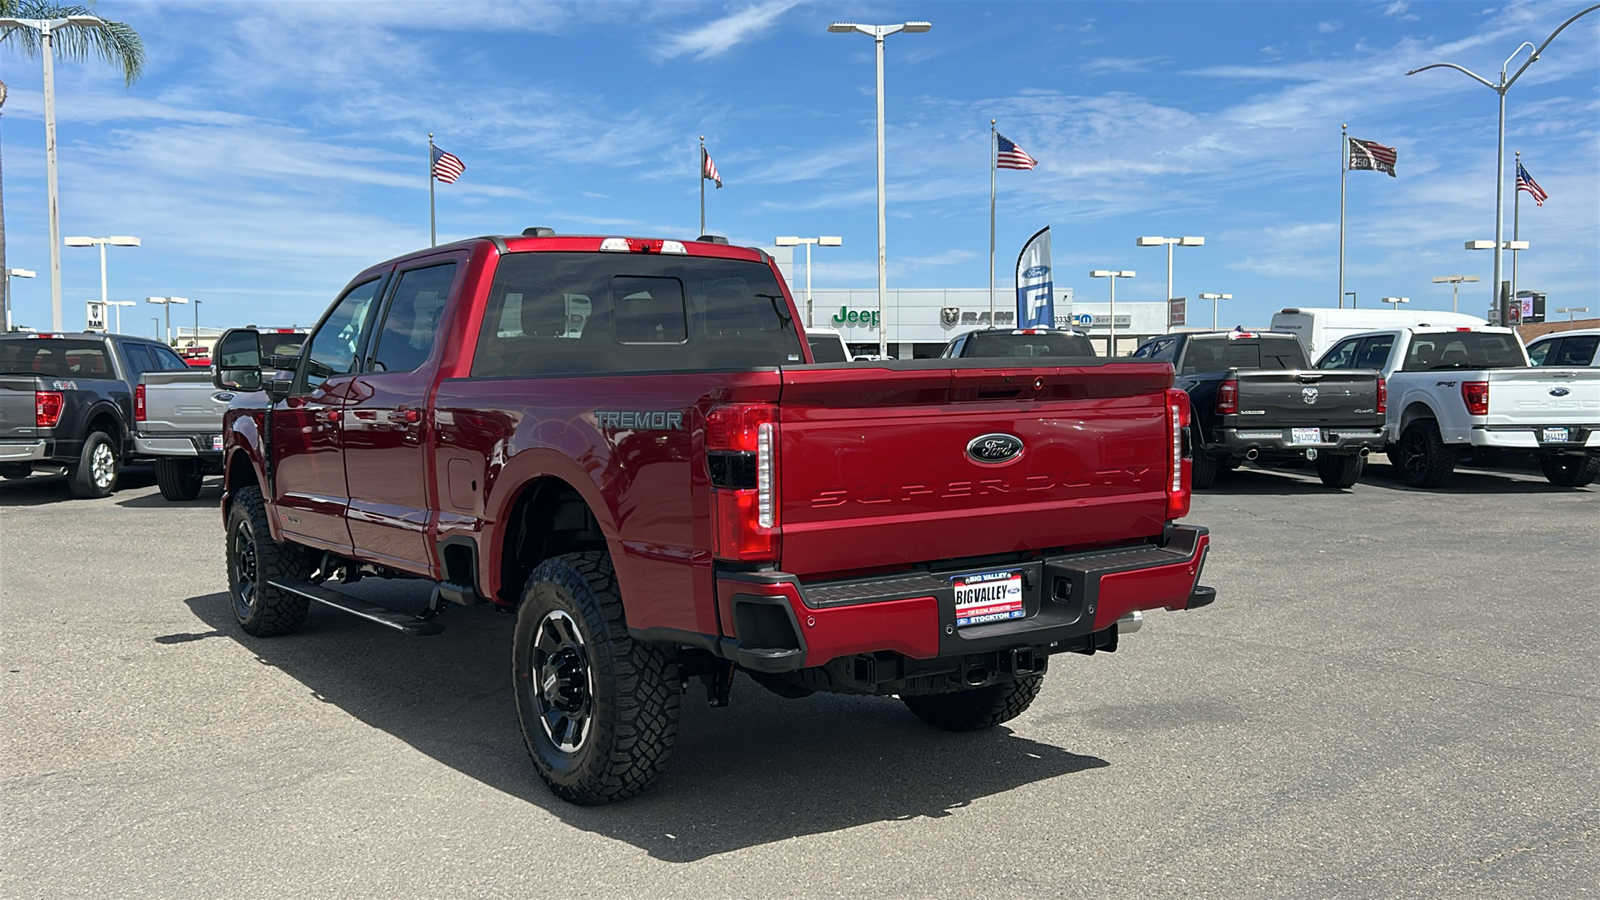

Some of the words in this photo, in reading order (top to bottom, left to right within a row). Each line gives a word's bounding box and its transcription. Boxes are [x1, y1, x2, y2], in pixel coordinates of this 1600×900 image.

[1351, 157, 1368, 167] 250
[1027, 267, 1046, 277] Ford
[833, 305, 880, 326] Jeep
[961, 311, 1014, 325] RAM
[594, 411, 683, 430] TREMOR
[981, 440, 1012, 456] Ford
[811, 478, 1011, 508] SUPER
[1026, 467, 1150, 492] DUTY
[983, 572, 1008, 580] VALLEY
[970, 612, 1010, 623] STOCKTON
